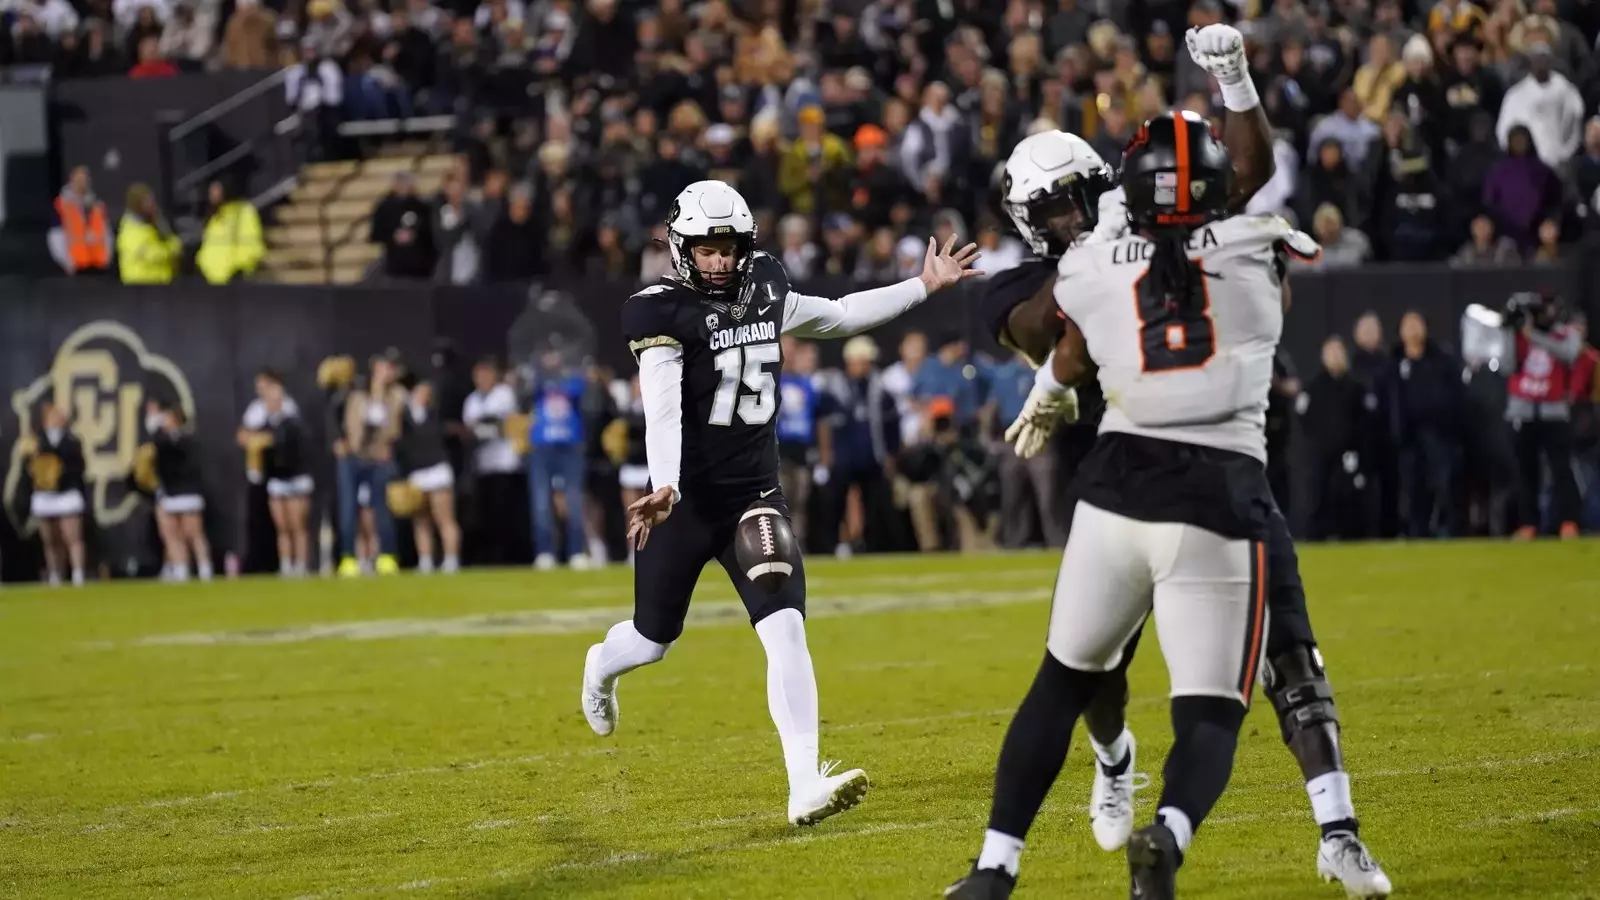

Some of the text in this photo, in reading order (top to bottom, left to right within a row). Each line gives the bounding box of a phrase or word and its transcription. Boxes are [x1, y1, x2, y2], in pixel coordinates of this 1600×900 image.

[709, 320, 776, 351] COLORADO
[1133, 256, 1216, 373] 8
[708, 343, 780, 426] 15
